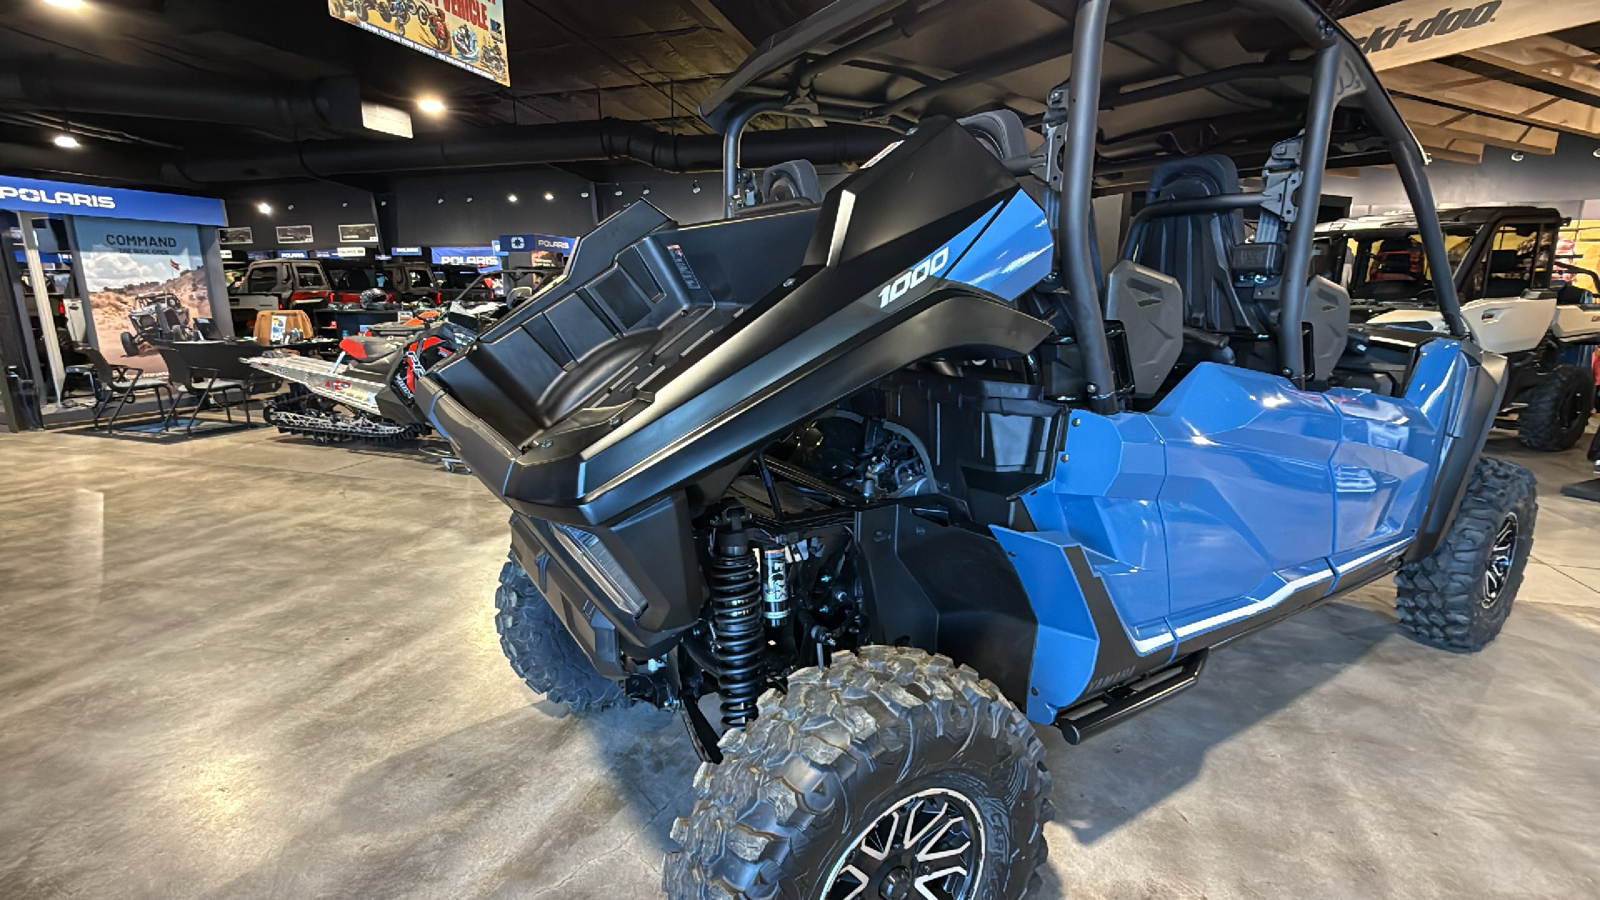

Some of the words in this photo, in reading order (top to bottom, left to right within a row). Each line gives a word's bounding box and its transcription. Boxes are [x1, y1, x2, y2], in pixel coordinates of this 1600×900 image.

[0, 186, 116, 209] POLARIS
[106, 234, 177, 248] COMMAND
[538, 239, 570, 249] POLARIS
[440, 256, 499, 265] POLARIS
[878, 246, 949, 308] 1000
